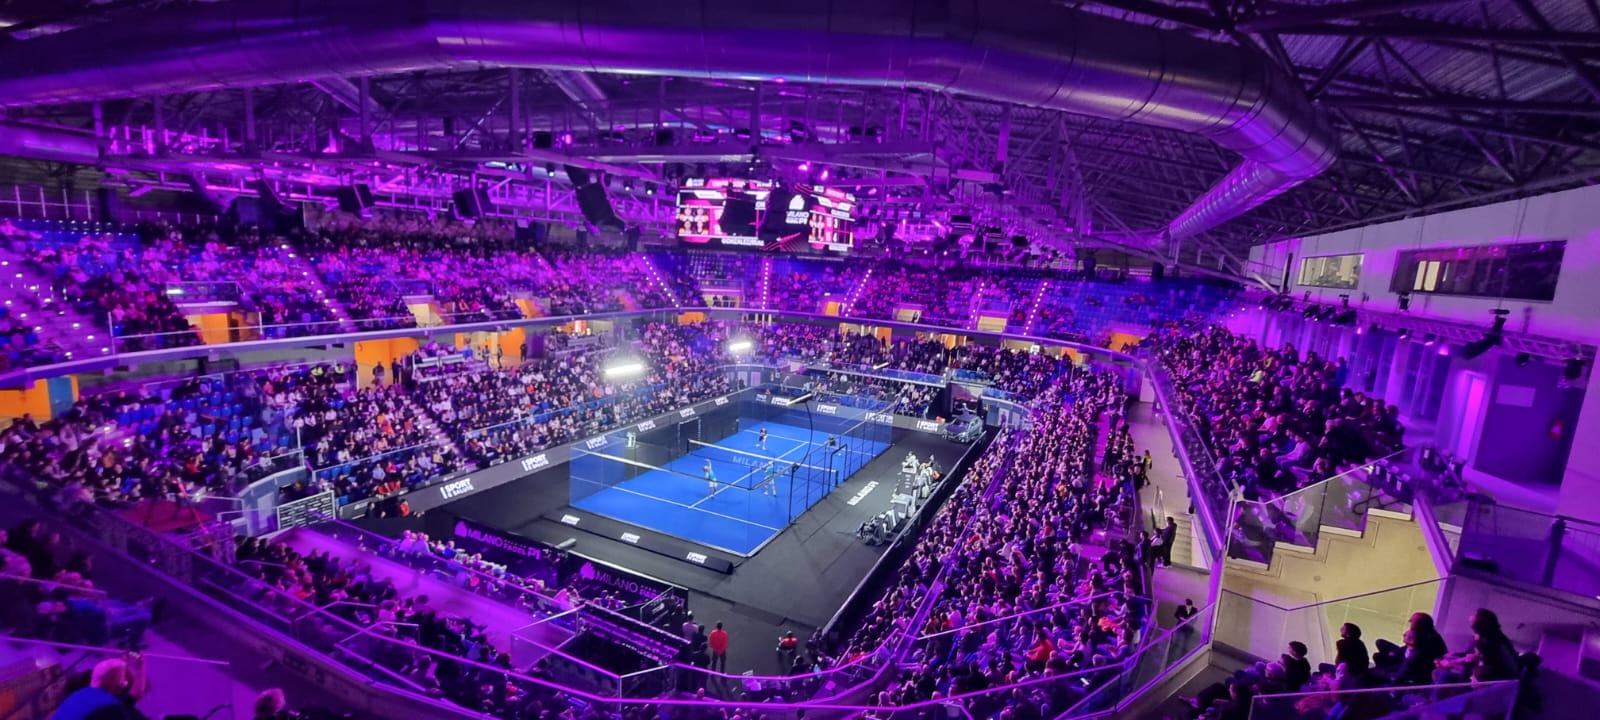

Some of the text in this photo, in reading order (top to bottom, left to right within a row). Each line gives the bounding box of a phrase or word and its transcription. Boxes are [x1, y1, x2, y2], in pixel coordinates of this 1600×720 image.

[525, 453, 546, 465] SPORT
[445, 478, 470, 493] SPORT
[468, 528, 503, 547] MILANO
[527, 546, 541, 560] P1
[596, 570, 639, 593] MILANO
